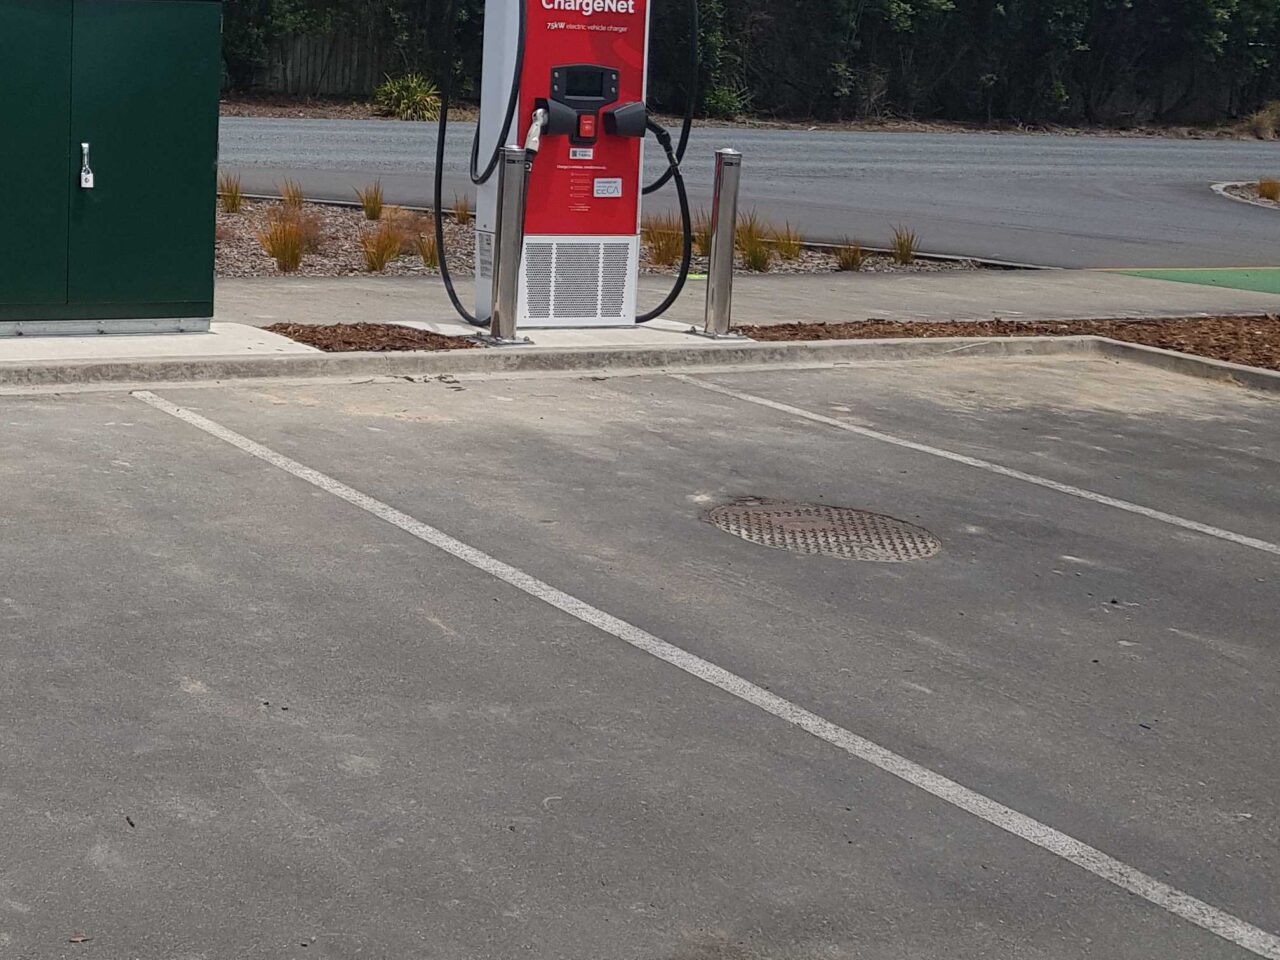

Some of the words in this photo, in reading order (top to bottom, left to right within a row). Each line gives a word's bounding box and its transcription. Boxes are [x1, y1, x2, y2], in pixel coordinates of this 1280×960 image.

[547, 21, 566, 30] 75kW
[566, 22, 586, 31] electric
[587, 24, 606, 32] vehicle
[607, 25, 628, 33] charger
